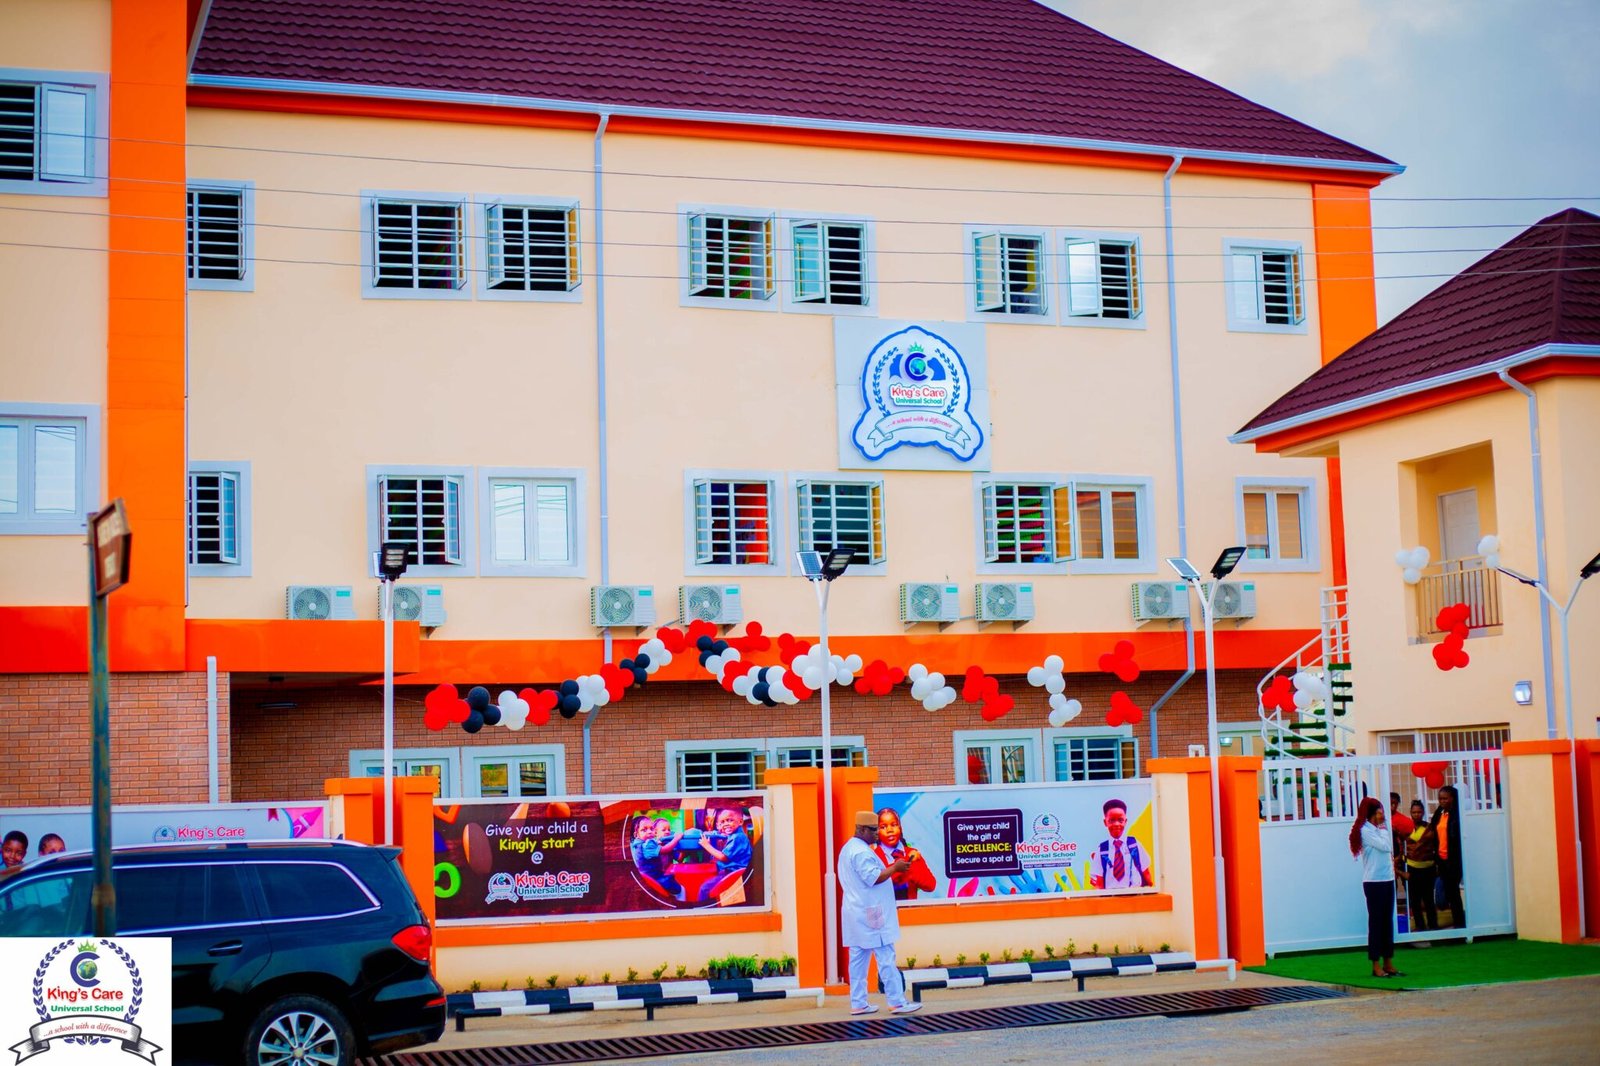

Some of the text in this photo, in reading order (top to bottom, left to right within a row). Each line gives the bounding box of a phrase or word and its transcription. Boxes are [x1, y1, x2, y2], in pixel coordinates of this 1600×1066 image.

[891, 385, 945, 398] King's Care
[923, 397, 943, 405] School
[485, 821, 588, 839] Give your child a
[957, 821, 1010, 832] Give your child
[178, 825, 245, 841] King's Care
[967, 832, 1001, 842] the gift of
[499, 837, 575, 853] Kingly start
[956, 842, 1012, 854] EXCELLENCE:
[1016, 841, 1077, 855] King's Care
[531, 851, 544, 865] @
[956, 856, 981, 864] Secure
[989, 855, 1004, 864] spot
[1005, 854, 1013, 862] at
[1018, 852, 1051, 860] Universal
[515, 871, 590, 887] King's Care
[518, 886, 558, 896] Universal
[560, 884, 589, 894] School
